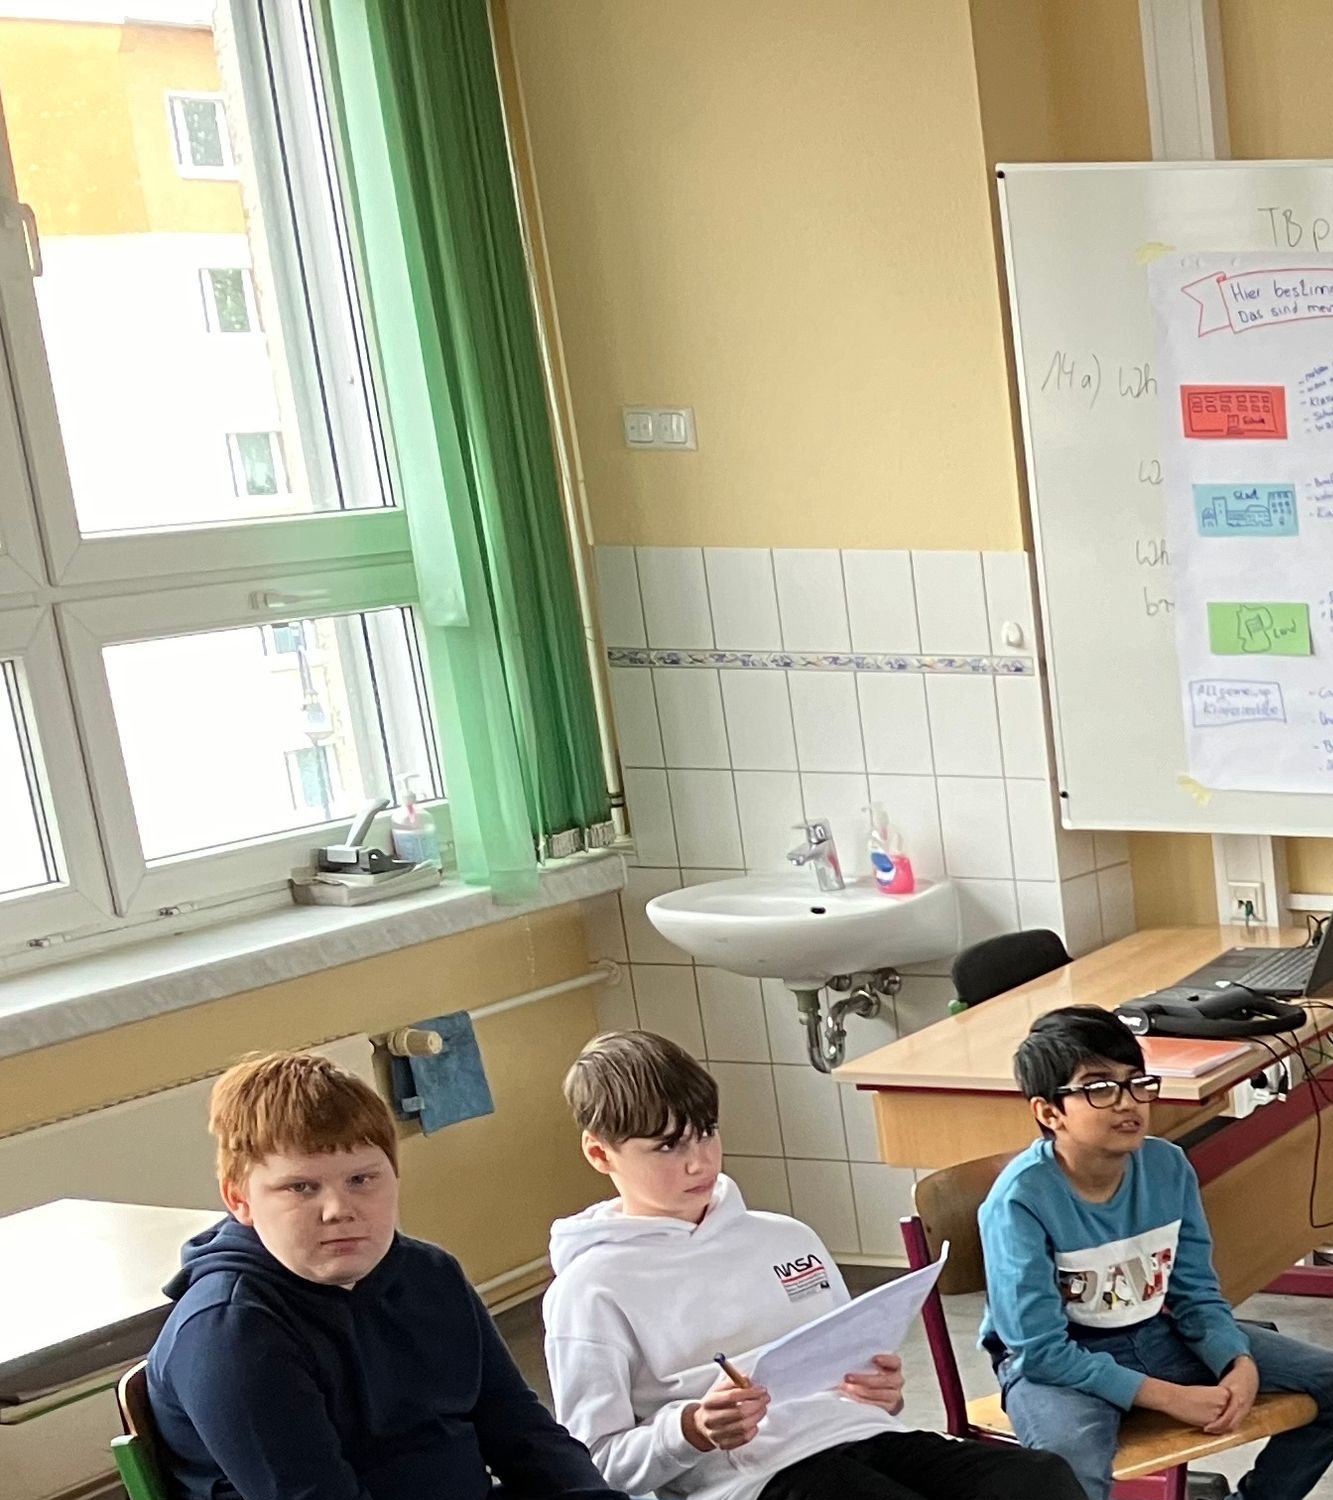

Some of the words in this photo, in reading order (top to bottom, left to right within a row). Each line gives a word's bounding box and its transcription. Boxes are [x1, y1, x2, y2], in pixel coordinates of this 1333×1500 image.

[1258, 207, 1303, 248] TB
[1230, 282, 1261, 301] Hier
[1237, 309, 1264, 324] Das
[1270, 300, 1299, 317] sind
[773, 1253, 823, 1280] NASA
